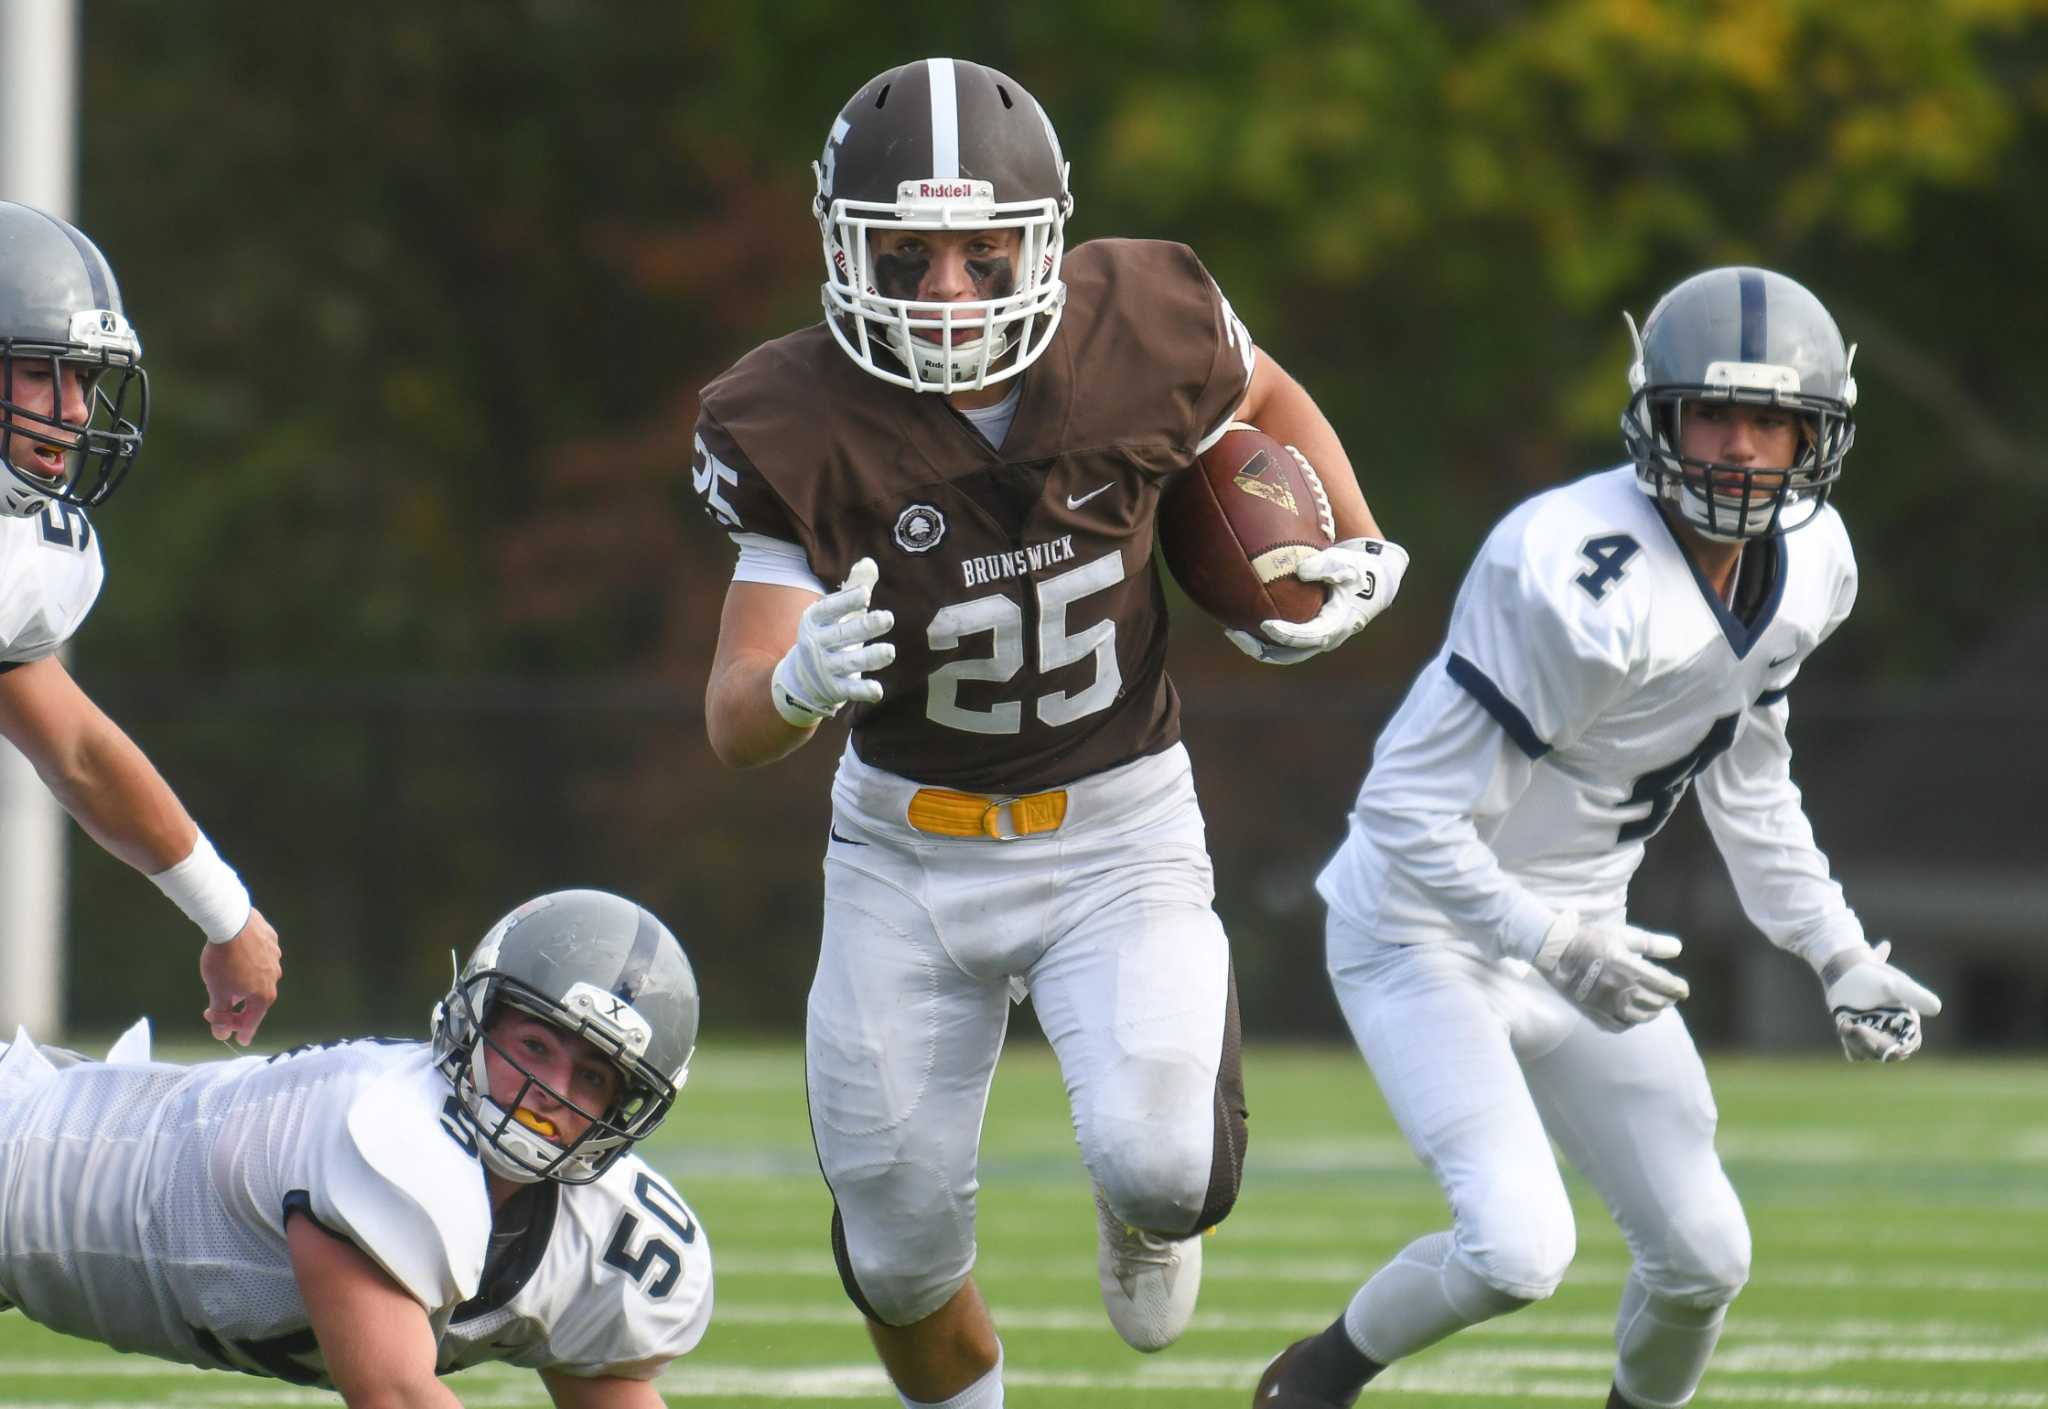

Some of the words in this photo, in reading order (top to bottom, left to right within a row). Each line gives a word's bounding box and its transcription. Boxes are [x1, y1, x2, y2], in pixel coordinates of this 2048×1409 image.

[920, 183, 972, 198] Riddell
[961, 534, 1075, 589] BRUNSWICK
[1571, 530, 1645, 606] 4
[925, 549, 1125, 735] 25
[602, 1171, 697, 1300] 50
